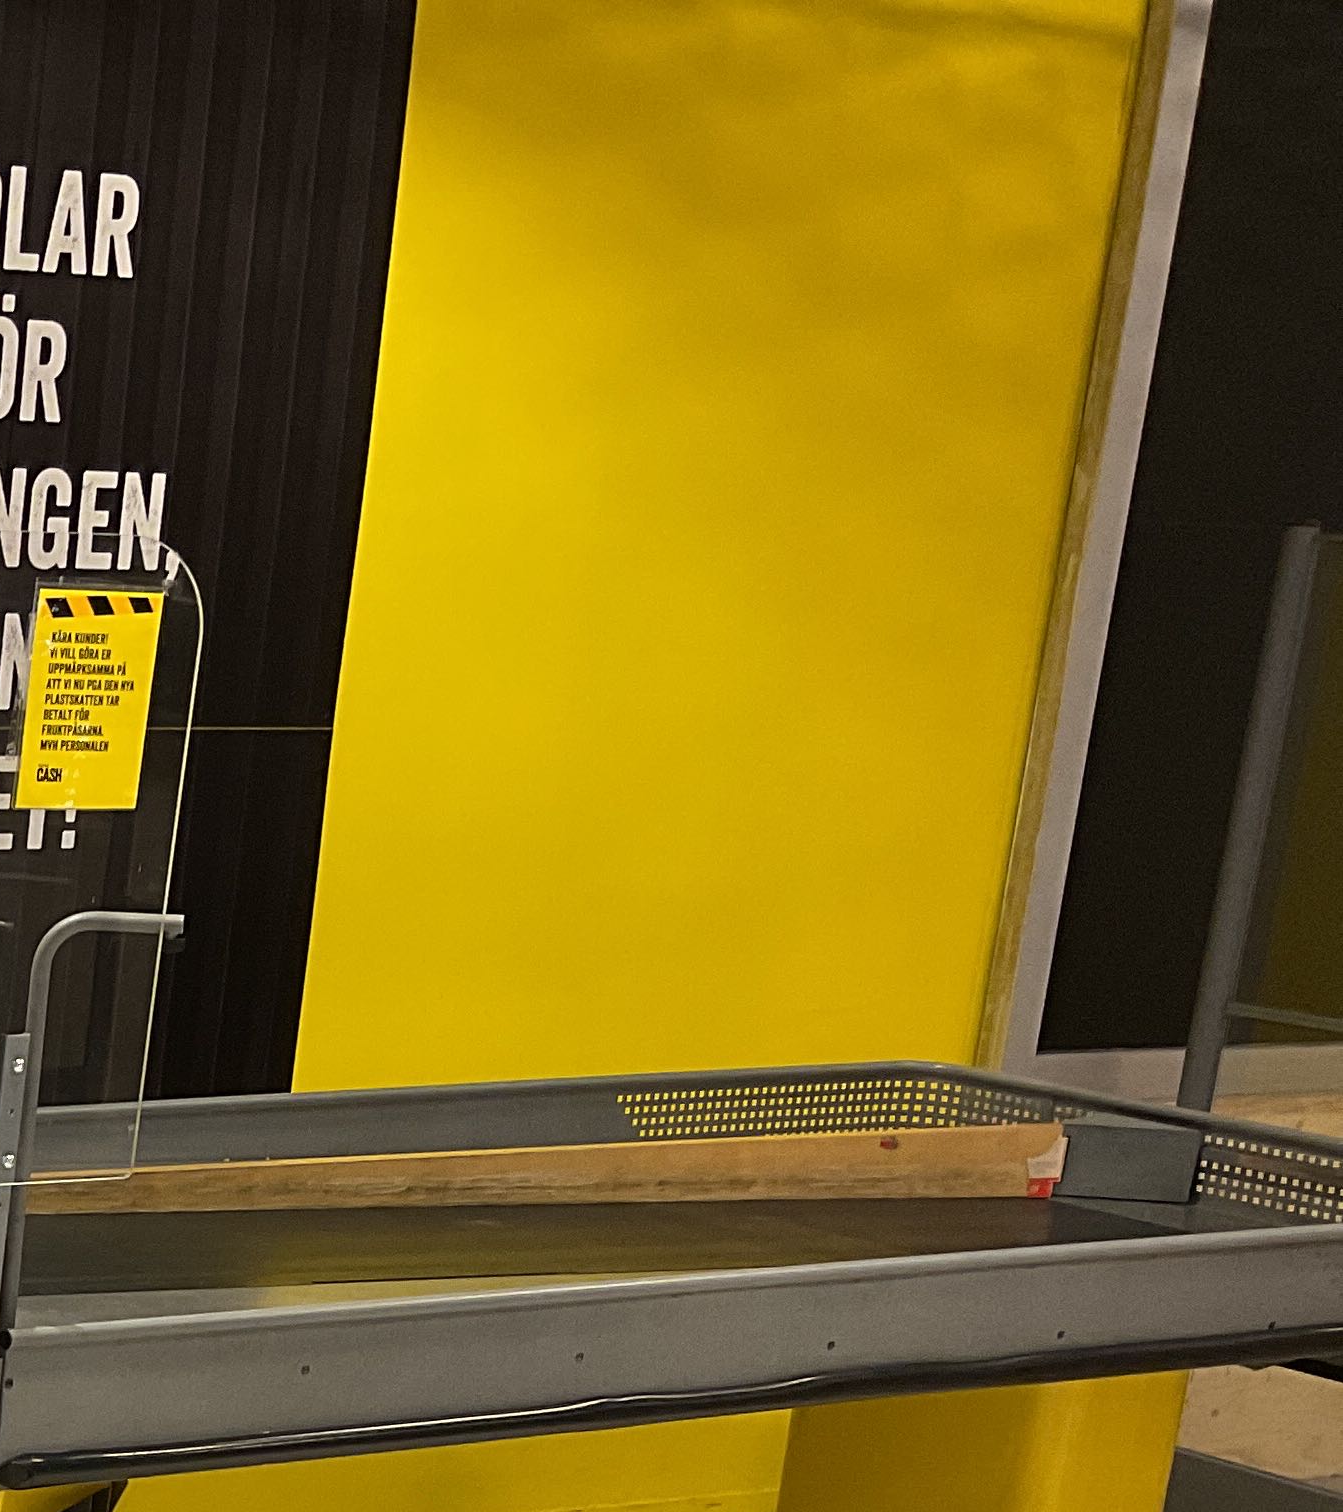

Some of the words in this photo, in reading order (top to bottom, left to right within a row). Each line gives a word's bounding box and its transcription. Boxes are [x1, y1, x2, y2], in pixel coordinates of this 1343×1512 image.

[60, 647, 77, 660] VILL
[78, 646, 100, 660] GÖRA
[101, 648, 112, 660] ER
[48, 661, 115, 676] UPPMÄRKSAMMA
[116, 661, 126, 676] PÅ
[45, 678, 62, 690] ATT
[63, 679, 72, 690] VI
[73, 679, 85, 690] NU
[86, 679, 102, 691] PGA
[103, 679, 119, 691] DEN
[120, 680, 134, 691] NYA
[44, 694, 104, 706] PLASTSKATTEN
[105, 695, 120, 706] TAR
[43, 709, 73, 721] BETALT
[74, 707, 90, 721] FÖR
[39, 739, 59, 751] MVH
[59, 740, 109, 752] PERSONALEN
[36, 767, 62, 782] CASH
